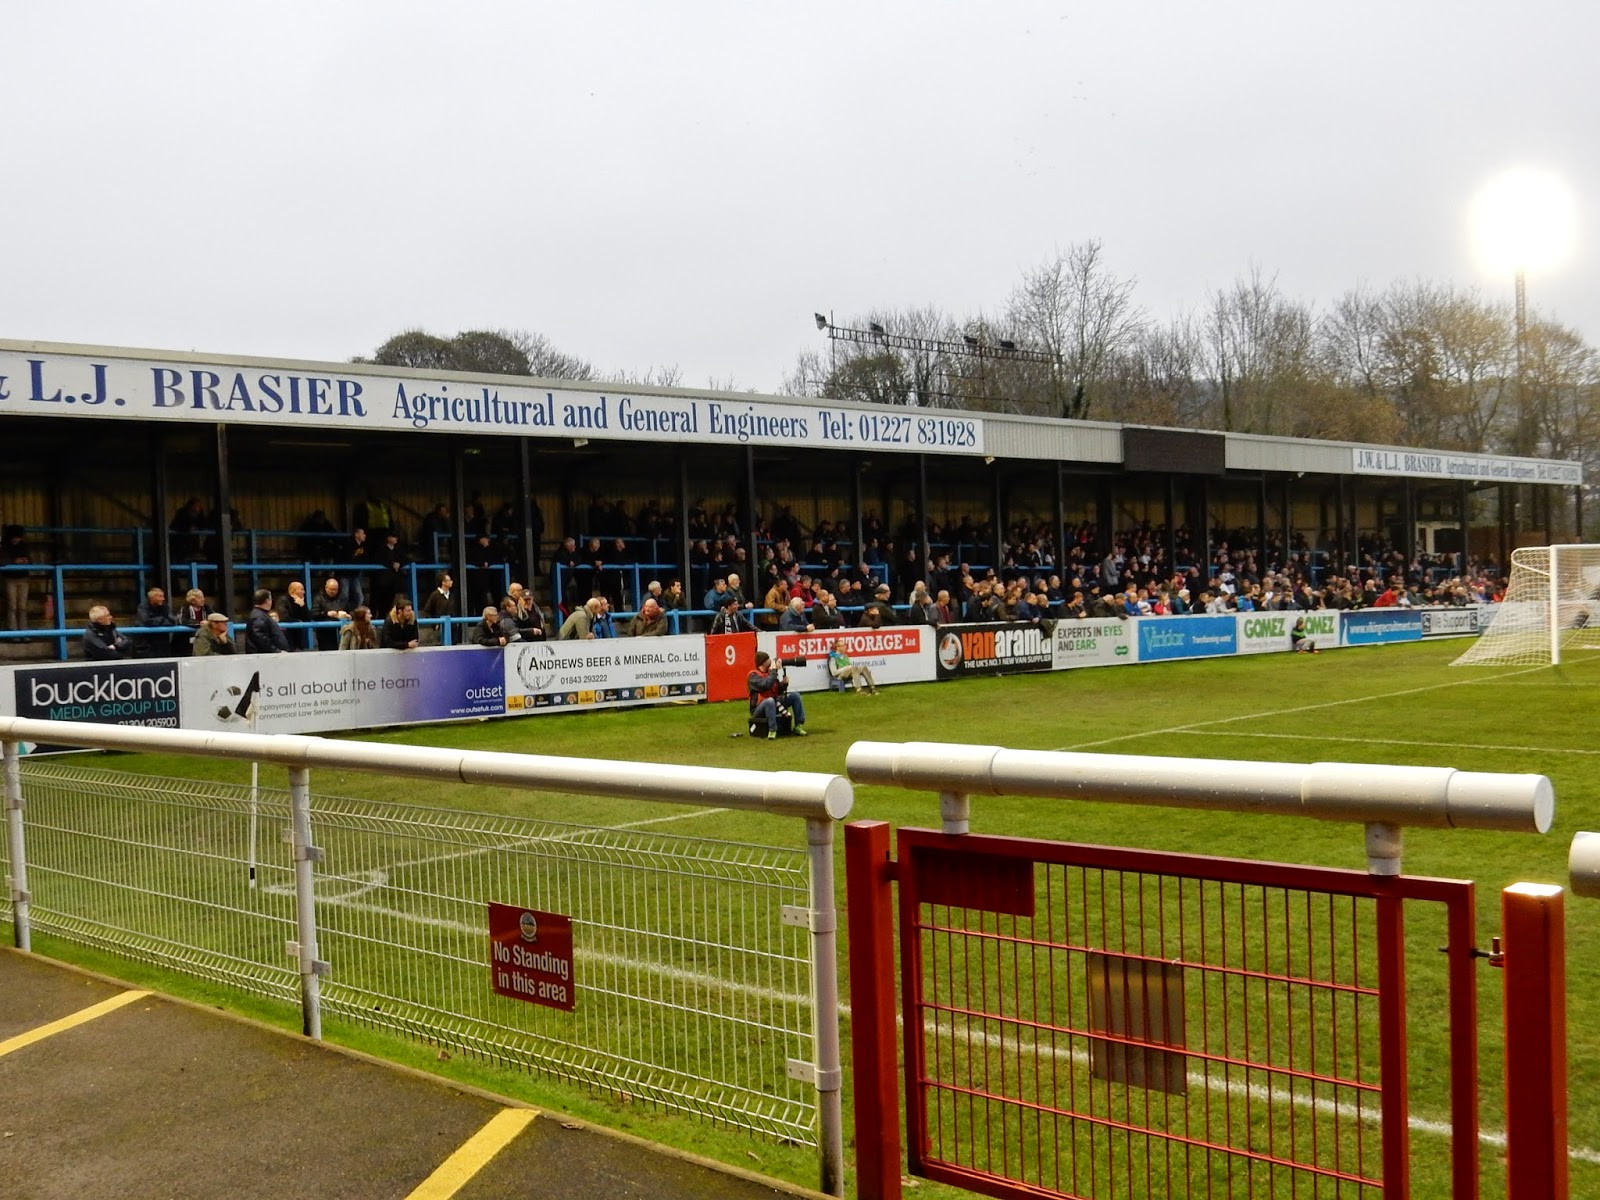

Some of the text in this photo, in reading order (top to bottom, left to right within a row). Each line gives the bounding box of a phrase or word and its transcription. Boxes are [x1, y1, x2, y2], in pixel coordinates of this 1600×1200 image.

[26, 359, 126, 407] L.J.
[150, 367, 368, 417] BRASIER
[392, 382, 555, 428] Agricultural
[563, 396, 609, 429] and
[618, 397, 698, 434] General
[708, 403, 808, 442] Engineers
[818, 410, 854, 441] Tel:
[859, 414, 912, 443] 01227
[917, 418, 976, 447] 831928
[1404, 454, 1442, 473] BRASIER
[1243, 617, 1286, 639] GOMEZ
[1304, 615, 1335, 635] OMEZ
[1442, 612, 1470, 631] Support
[1057, 625, 1123, 639] EXPERTS IN EYES
[1057, 638, 1097, 651] AND EARS
[528, 651, 700, 671] ANDREWS BEER & MINERAL Co. Ltd.
[724, 644, 736, 666] 9
[964, 660, 976, 669] THE
[976, 659, 989, 668] UK'S
[989, 658, 1002, 667] NO.1
[1002, 657, 1015, 666] NEW
[1015, 656, 1027, 665] VAN
[560, 674, 608, 685] 01843 293222
[635, 669, 700, 680] andrewsbeers.co.uk
[31, 670, 176, 706] buckland
[278, 682, 297, 697] all
[301, 679, 347, 695] about
[352, 677, 377, 692] the
[381, 676, 421, 690] team
[465, 684, 503, 699] outset
[49, 699, 177, 721] MEDIA GROUP LTD
[298, 701, 312, 709] Law
[330, 698, 360, 706] Solutions
[145, 716, 177, 728] 205900
[259, 707, 341, 720] ommercial Law Services
[493, 940, 569, 981] No Standing
[497, 966, 567, 1003] in this area
